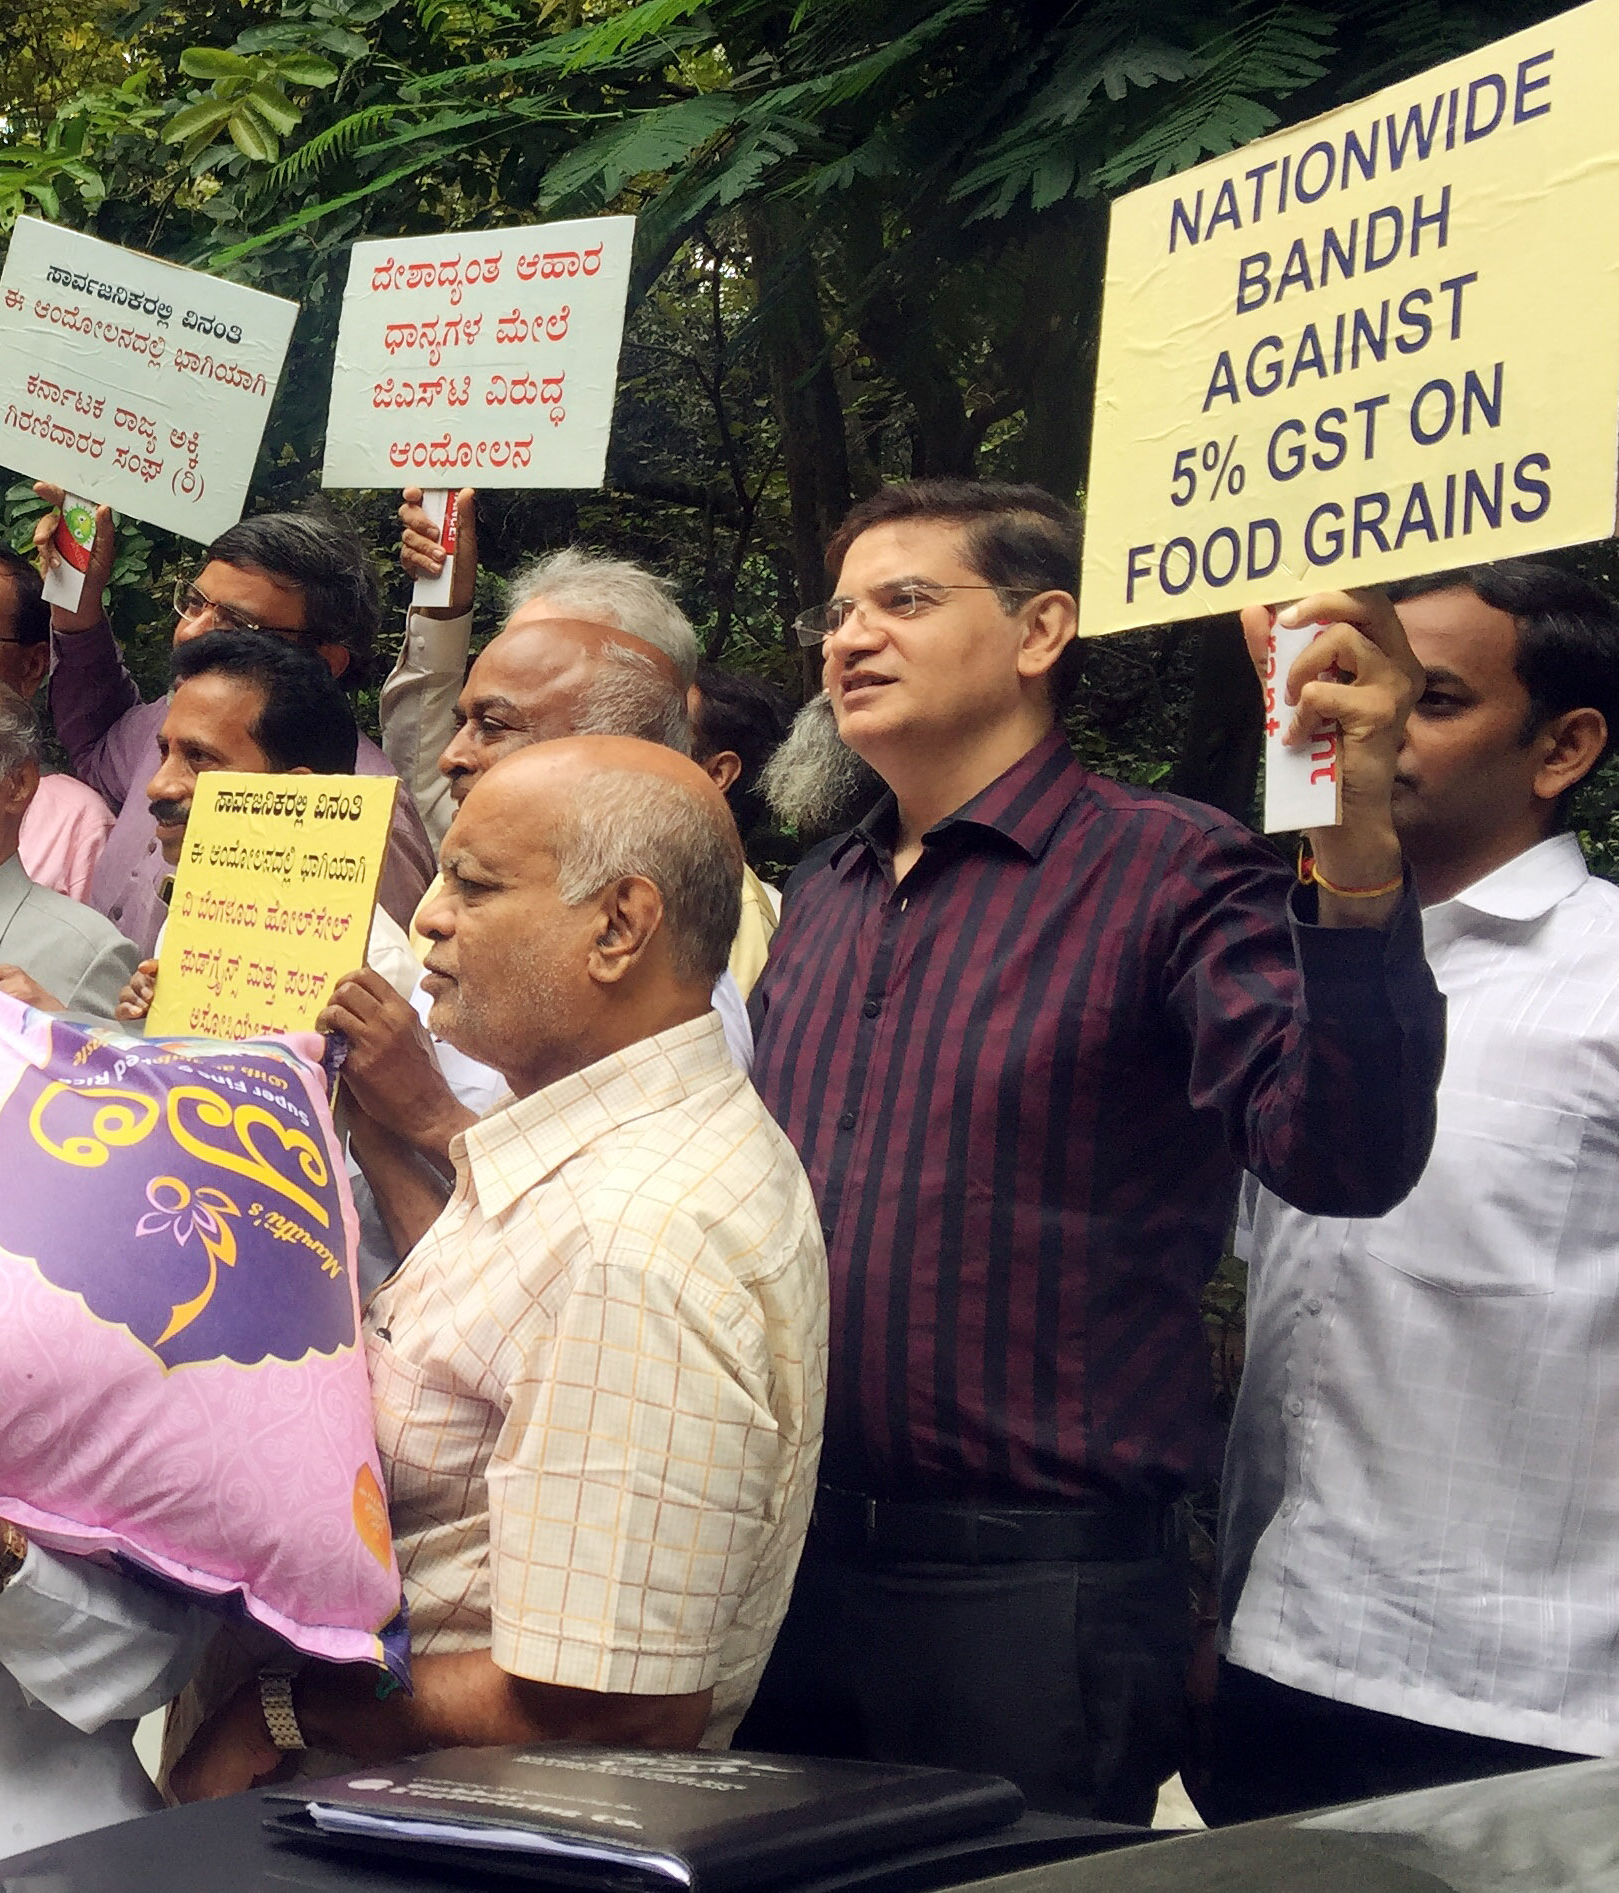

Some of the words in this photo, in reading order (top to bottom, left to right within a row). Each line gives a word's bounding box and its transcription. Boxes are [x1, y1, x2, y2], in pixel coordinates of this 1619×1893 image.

[1168, 48, 1556, 254] NATIONWIDE
[371, 250, 503, 306] ದೇಶಾದ್ಯಂತ
[517, 241, 604, 281] ಆಹಾರ
[1237, 184, 1453, 316] BANDH
[46, 264, 173, 329] ಸಾರ್ವಜನಿಕರಲ್ಲಿ
[182, 309, 243, 345] ವಿನಂತಿ
[384, 312, 483, 367] ಧಾನ್ಯಗಳ
[496, 305, 571, 345] ಮೇಲೆ
[4, 288, 24, 312] ಈ
[34, 299, 167, 368] ಆಂದೋಲನದಲ್ಲಿ
[174, 347, 267, 397] ಭಾಗಿಯಾಗಿ
[1202, 271, 1479, 414] AGAINST
[27, 373, 106, 419] ಕರ್ನಾಟಕ
[114, 407, 158, 454] ರಾಜ್ಯ
[169, 427, 200, 470] ಅಕ್ಕಿ
[485, 370, 567, 428] ವಿರುದ್ಧ
[112, 445, 164, 483] ಸಂಘ
[389, 432, 534, 469] ಆಂದೋಲನ
[1170, 434, 1246, 508] 5%
[1267, 393, 1391, 483] GST
[1410, 361, 1505, 447] ON
[1125, 517, 1282, 605] FOOD
[1303, 451, 1553, 568] GRAINS
[214, 785, 308, 828] ಸಾರ್ವಜನಿಕರಲ್ಲಿ
[313, 793, 363, 822] ವಿನಂತಿ
[190, 841, 204, 865] ಈ
[209, 839, 296, 886] ಆಂದೋಲನದಲ್ಲಿ
[300, 850, 367, 884] ಭಾಗಿಯಾಗಿ
[197, 890, 259, 928] ಬೆಂಗಳೂರು
[246, 957, 278, 1006] ಮತ್ತು
[253, 1086, 310, 1128] Super
[248, 1202, 344, 1280] Maruthi's
